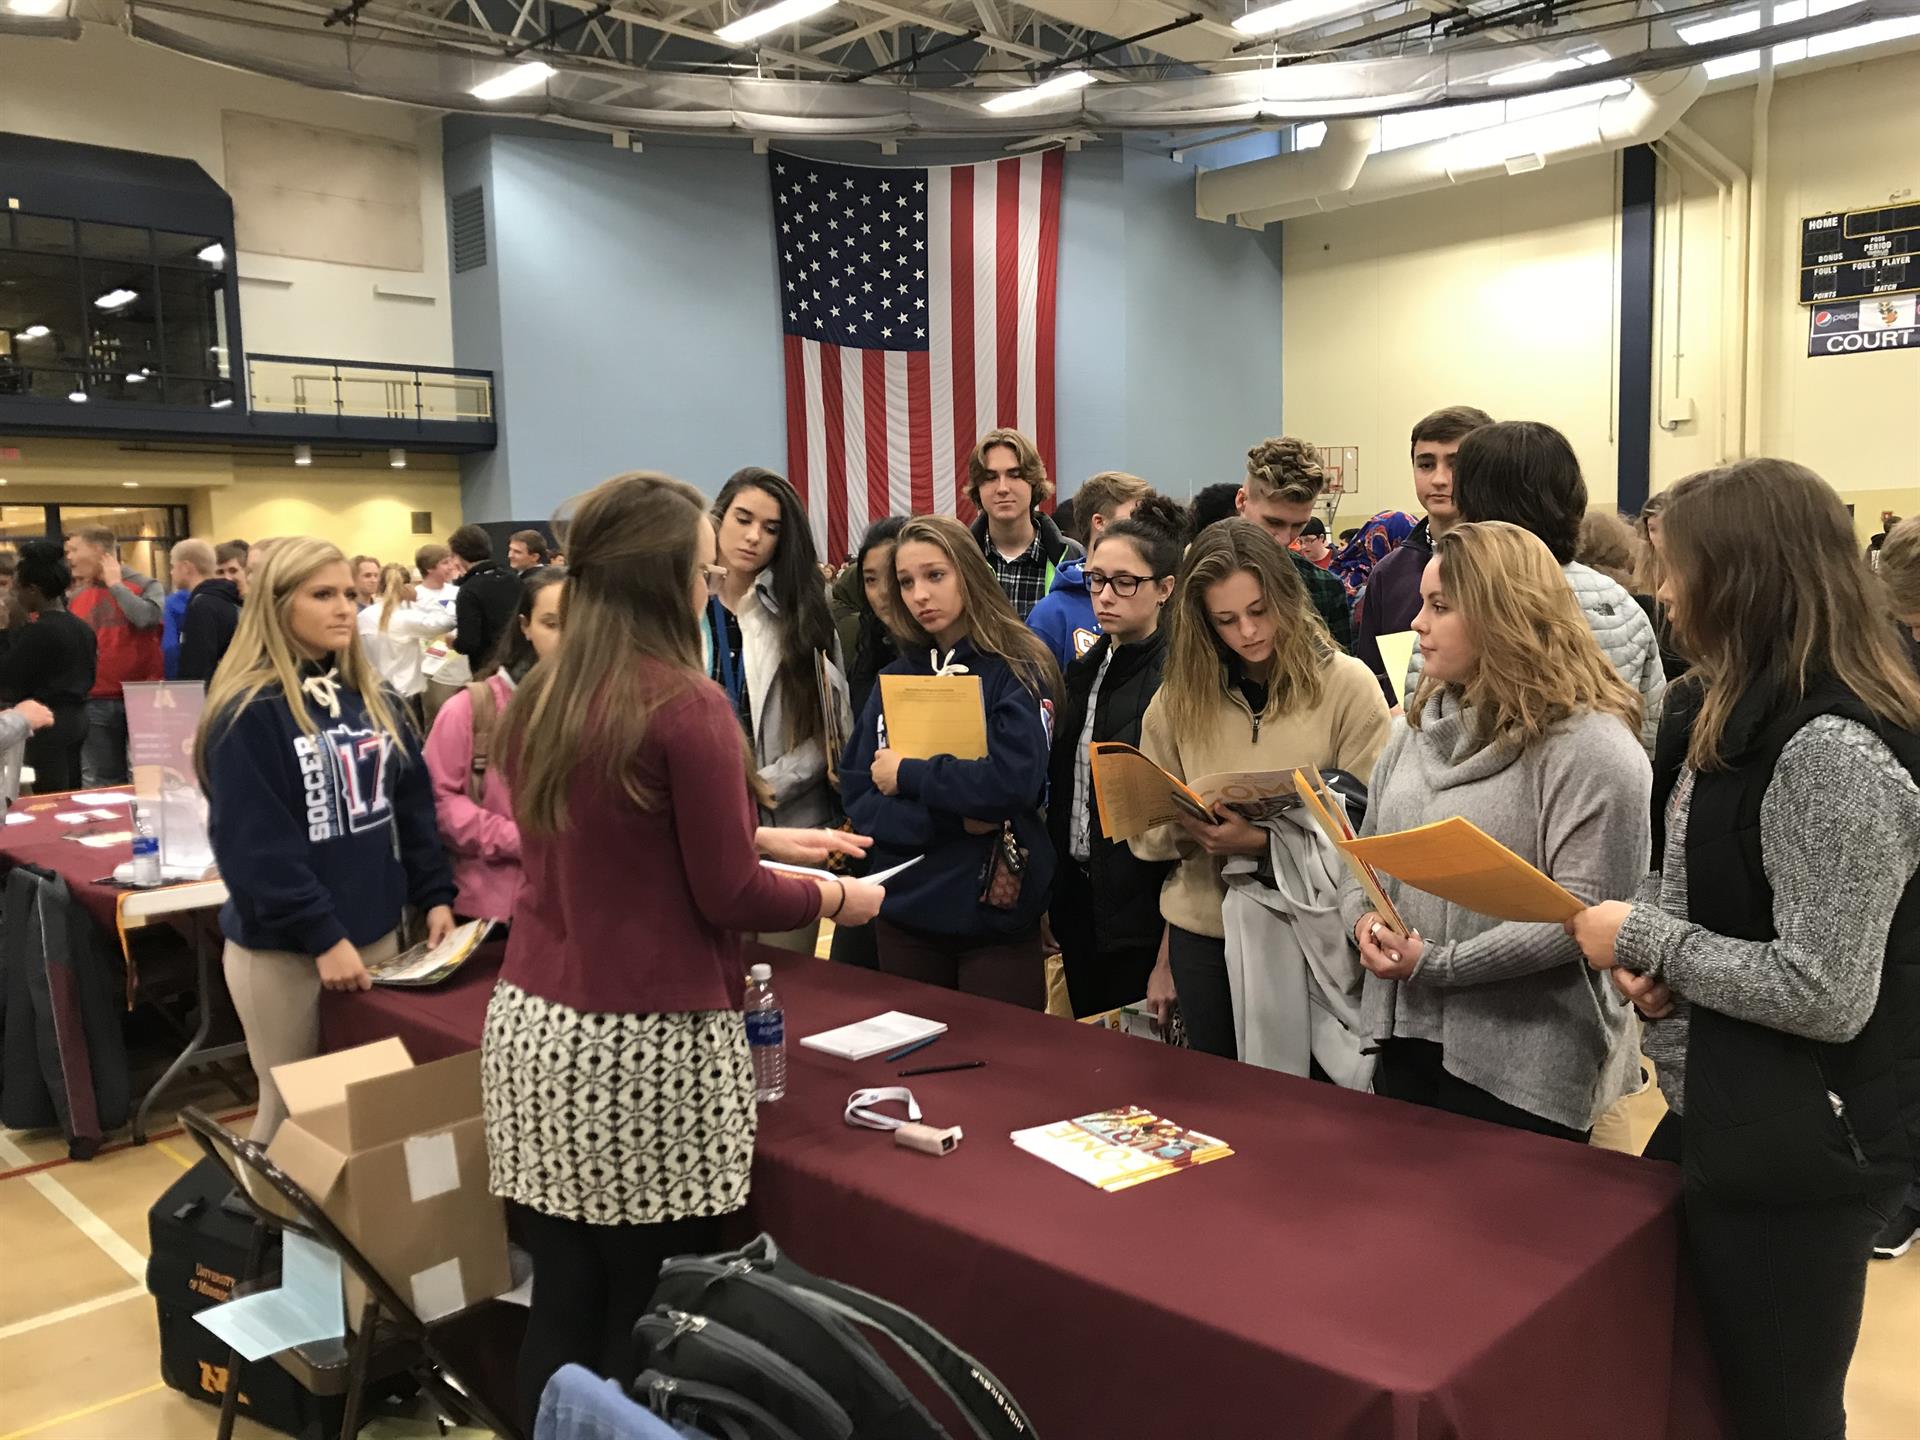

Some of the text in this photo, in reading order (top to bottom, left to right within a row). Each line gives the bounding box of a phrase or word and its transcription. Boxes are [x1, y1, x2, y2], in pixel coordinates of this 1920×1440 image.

[1808, 217, 1838, 231] HOME
[1863, 241, 1892, 252] PERIOD
[1818, 253, 1844, 263] BONUS
[1852, 256, 1911, 271] FOULS PLAYER
[1814, 266, 1838, 276] FOULS
[1873, 283, 1898, 293] MATCH
[1813, 291, 1837, 300] POINTS
[1833, 312, 1858, 323] pepsi
[1826, 329, 1915, 353] COURT
[336, 736, 387, 817] 17
[293, 735, 331, 842] SOCCER
[1004, 1402, 1024, 1433] HIGH
